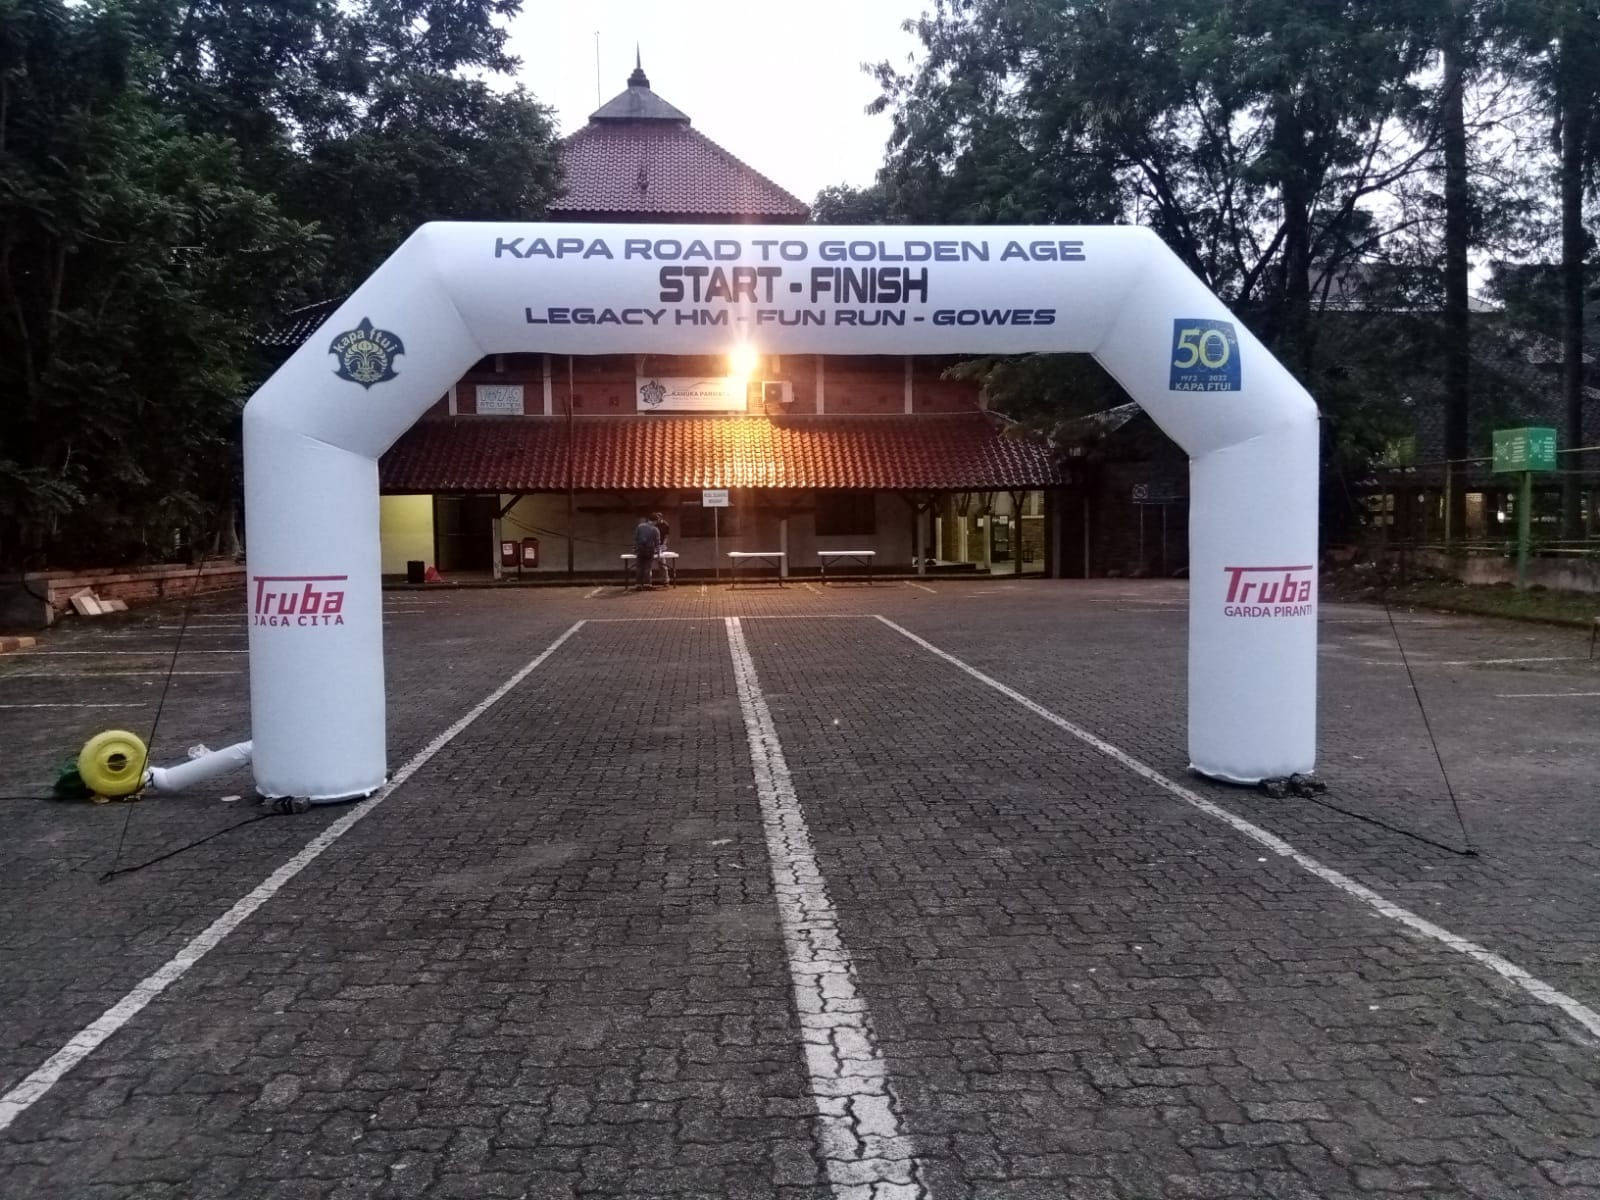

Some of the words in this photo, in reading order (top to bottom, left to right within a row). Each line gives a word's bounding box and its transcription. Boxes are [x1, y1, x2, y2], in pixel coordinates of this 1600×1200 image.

[494, 237, 614, 260] KAPA
[624, 239, 742, 261] ROAD
[751, 240, 809, 261] TO
[818, 240, 990, 262] GOLDEN
[999, 240, 1086, 262] AGE
[659, 266, 782, 303] START
[810, 267, 928, 303] FINISH
[525, 307, 667, 325] LEGACY
[674, 309, 728, 326] HM
[756, 309, 826, 326] FUN
[834, 309, 906, 326] RUN
[932, 308, 1056, 326] GOWES
[1173, 329, 1229, 369] 50
[1175, 382, 1205, 391] KAPA
[1207, 382, 1231, 391] FTUI
[253, 575, 348, 615] Truba
[1224, 565, 1313, 604] Truba
[253, 615, 290, 627] JAGA
[297, 614, 345, 627] CITA
[1224, 606, 1272, 618] GARDA
